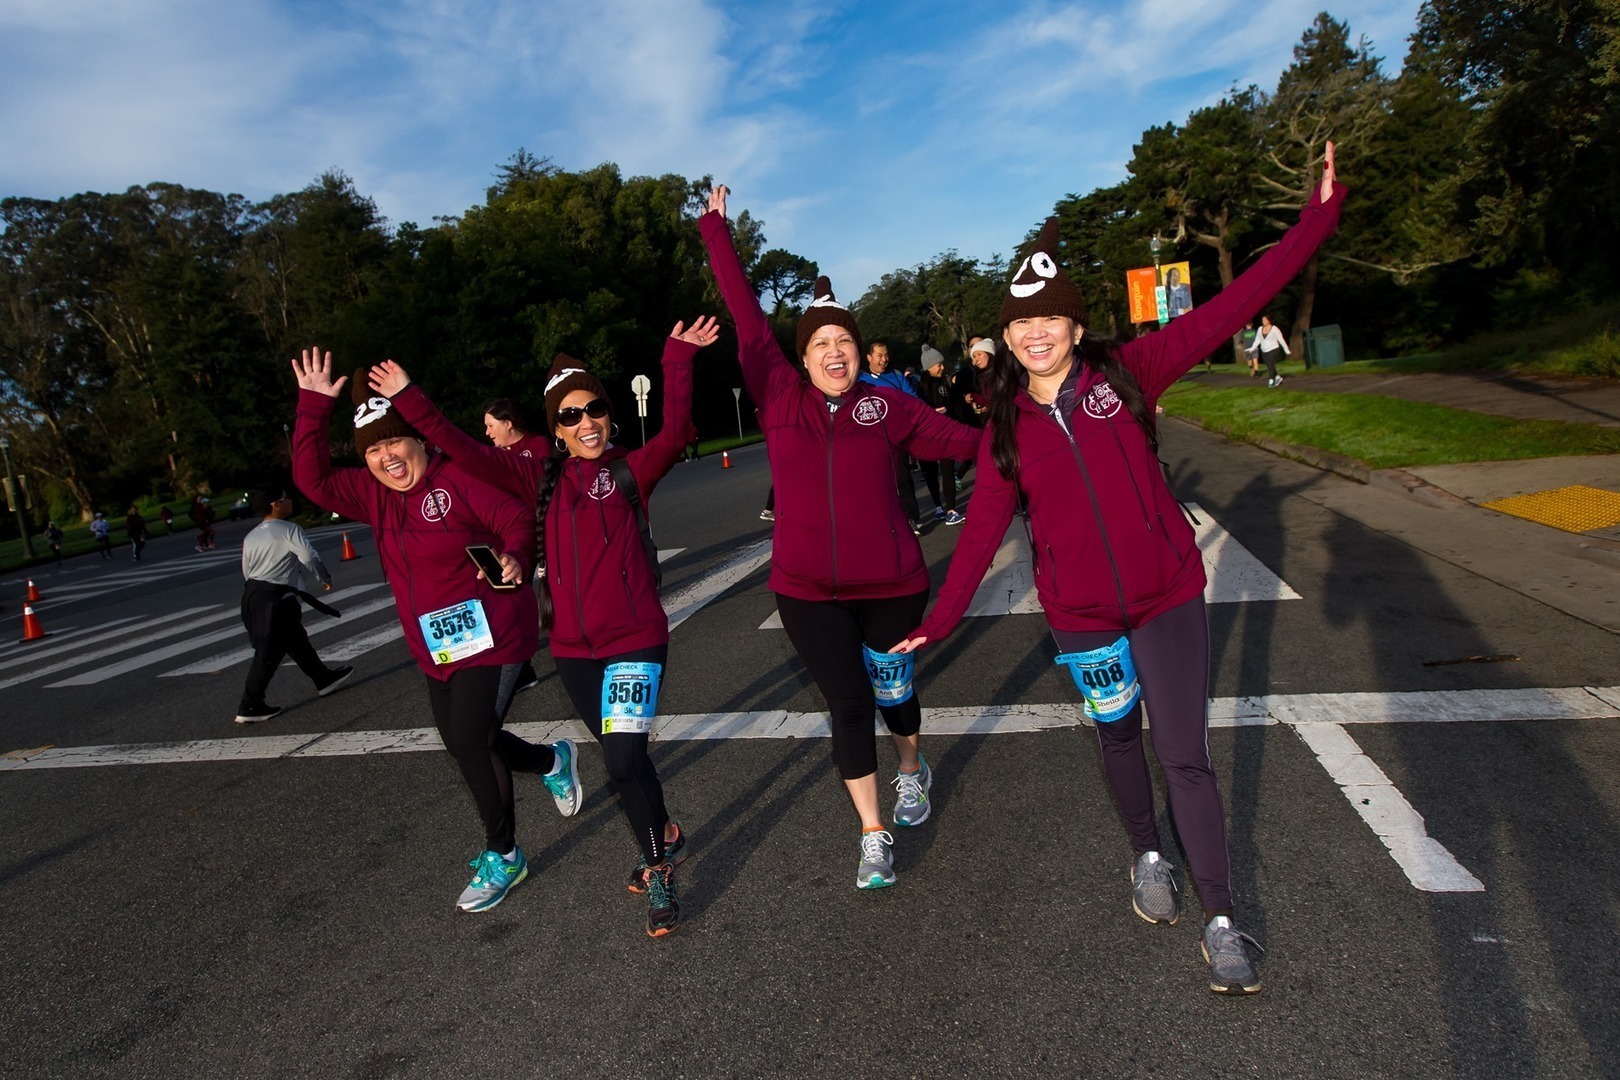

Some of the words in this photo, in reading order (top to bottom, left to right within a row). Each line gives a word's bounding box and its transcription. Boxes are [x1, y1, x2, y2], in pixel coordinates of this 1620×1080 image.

[1132, 281, 1143, 320] Gauguin
[429, 609, 477, 640] 3576
[439, 653, 448, 662] D
[1080, 651, 1104, 660] CHECK
[869, 662, 907, 682] 3577
[1082, 662, 1125, 689] 408
[607, 682, 652, 705] 3581
[1103, 689, 1115, 697] 5k
[1096, 697, 1120, 707] Sheila
[604, 719, 610, 732] F
